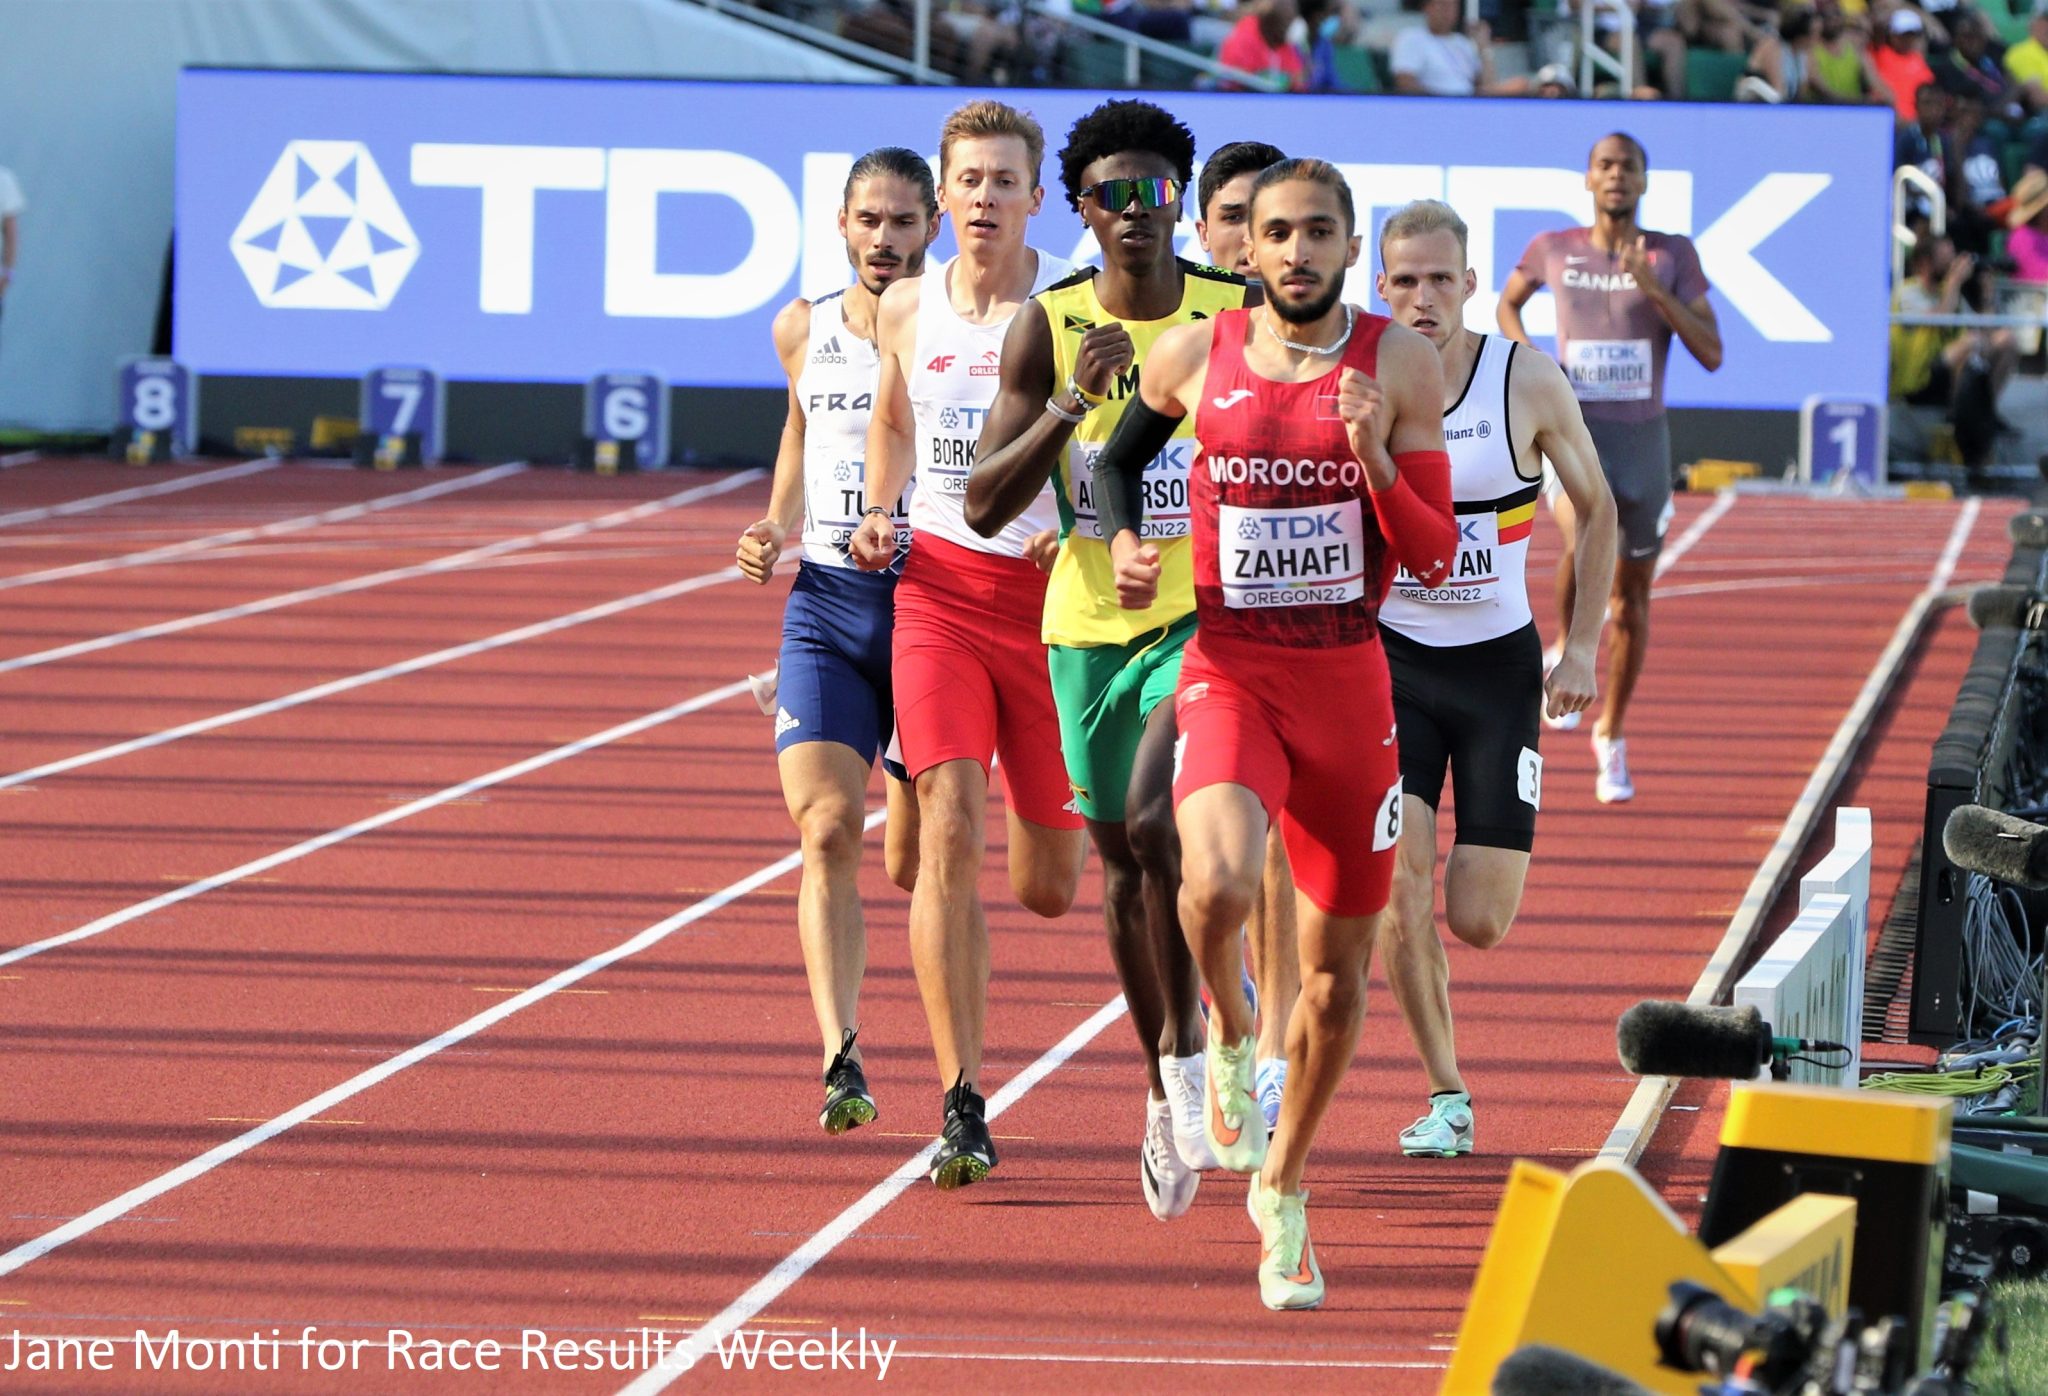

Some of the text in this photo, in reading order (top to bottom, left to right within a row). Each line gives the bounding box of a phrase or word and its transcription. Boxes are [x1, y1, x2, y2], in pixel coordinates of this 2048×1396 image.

[811, 353, 847, 365] adidas
[926, 354, 956, 373] 4F
[970, 366, 999, 375] ORLEN
[133, 377, 176, 431] 8
[380, 383, 424, 434] 7
[603, 386, 649, 440] 6
[1829, 418, 1858, 470] 1
[1207, 455, 1361, 488] MOROCCO
[1260, 511, 1343, 540] TDK
[1234, 543, 1350, 579] ZAHAFI
[1243, 587, 1347, 606] OREGON22
[1400, 588, 1482, 601] OREGON22
[1388, 794, 1399, 839] 8
